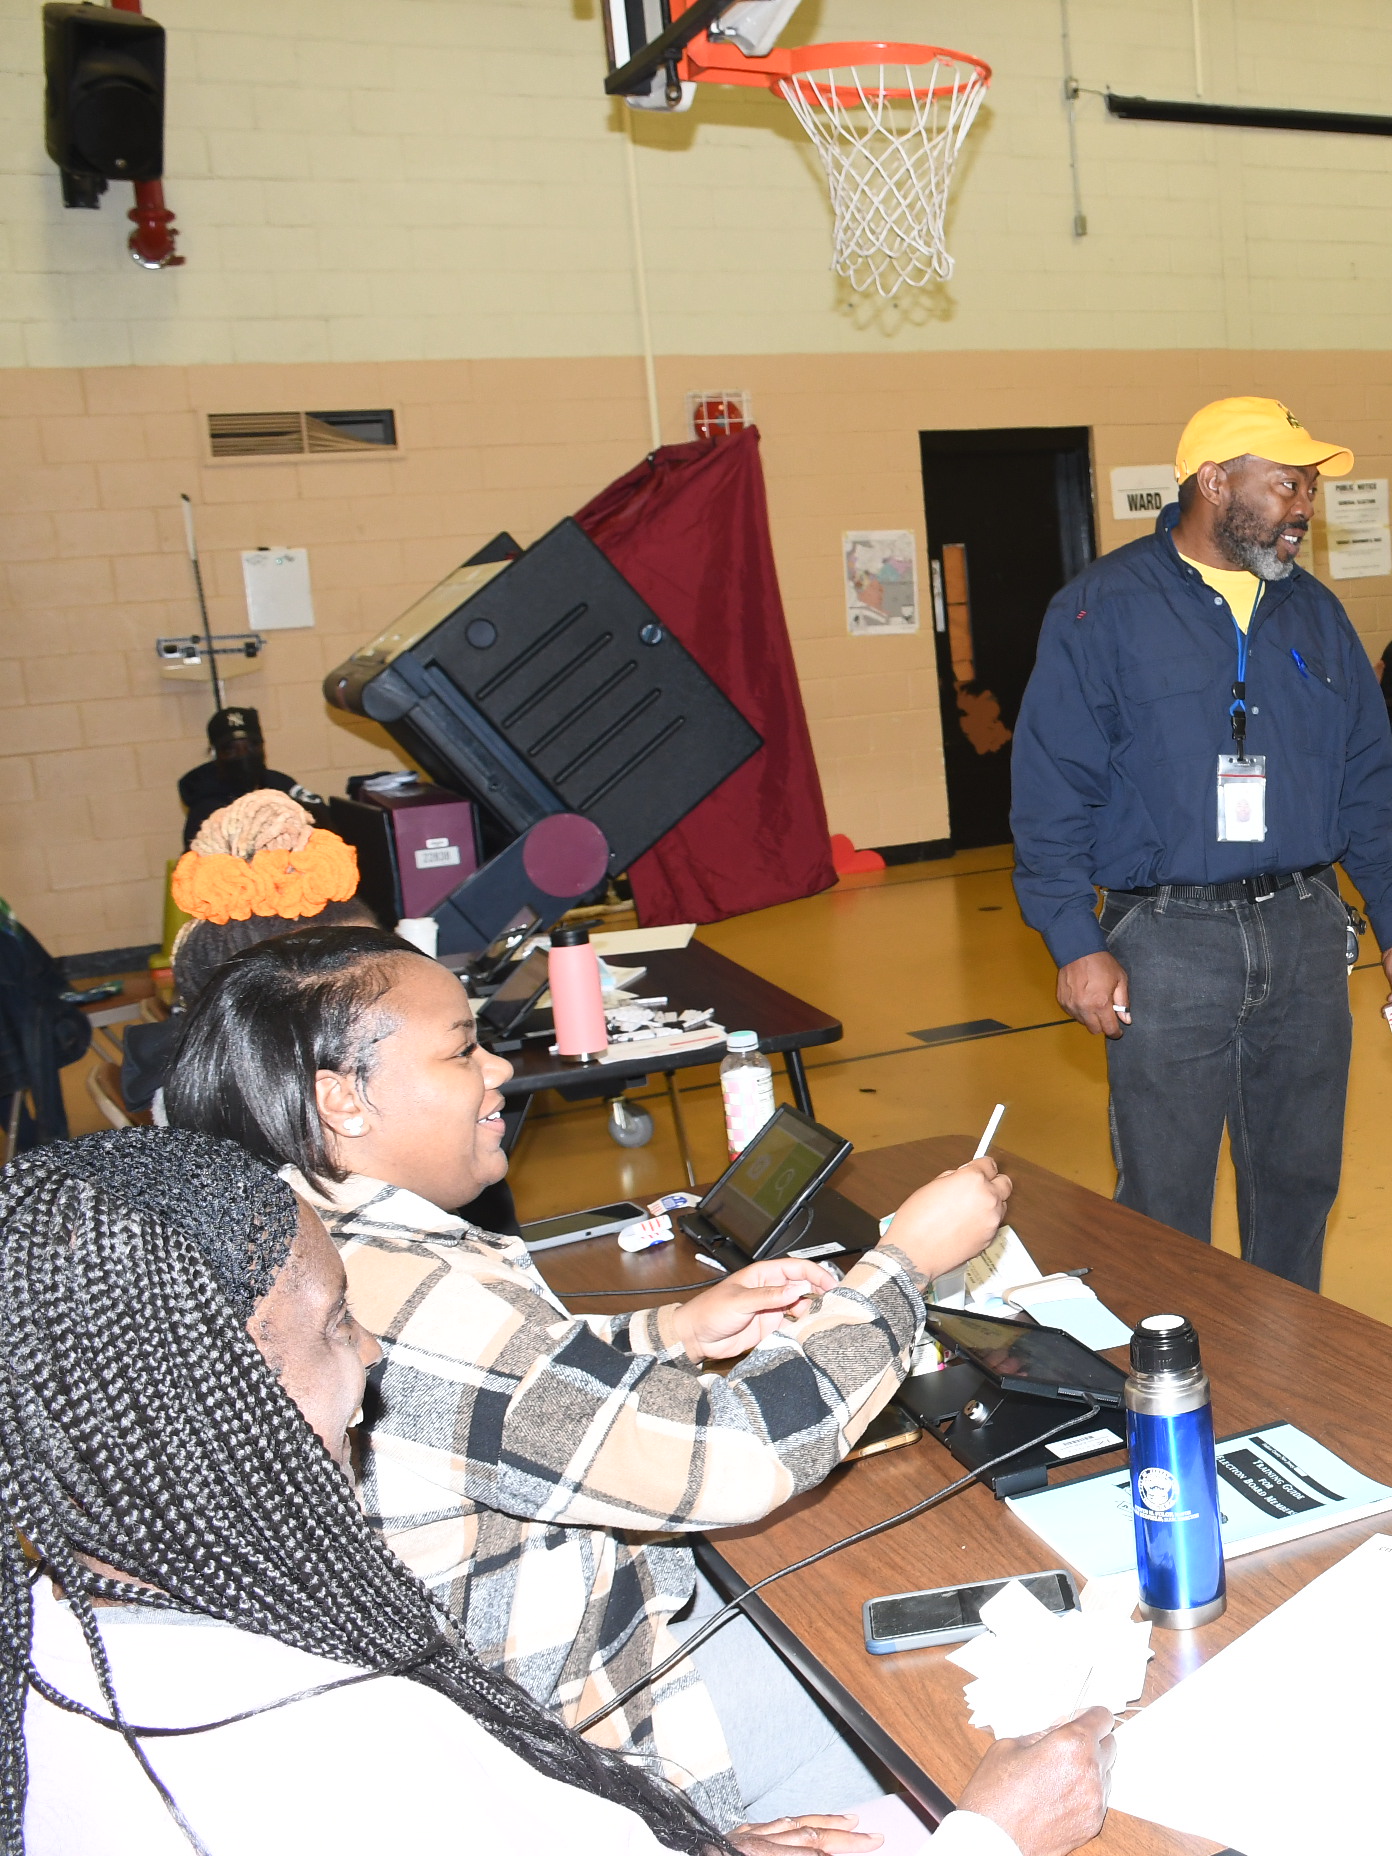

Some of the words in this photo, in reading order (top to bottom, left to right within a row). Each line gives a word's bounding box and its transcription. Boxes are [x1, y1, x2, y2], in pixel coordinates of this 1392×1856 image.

[1127, 492, 1162, 511] WARD
[1216, 1454, 1247, 1480] ELECTION
[1243, 1478, 1267, 1497] BOARD
[1252, 1459, 1284, 1485] TRAINING
[1282, 1484, 1306, 1500] GUIDE
[1258, 1478, 1274, 1490] FOR
